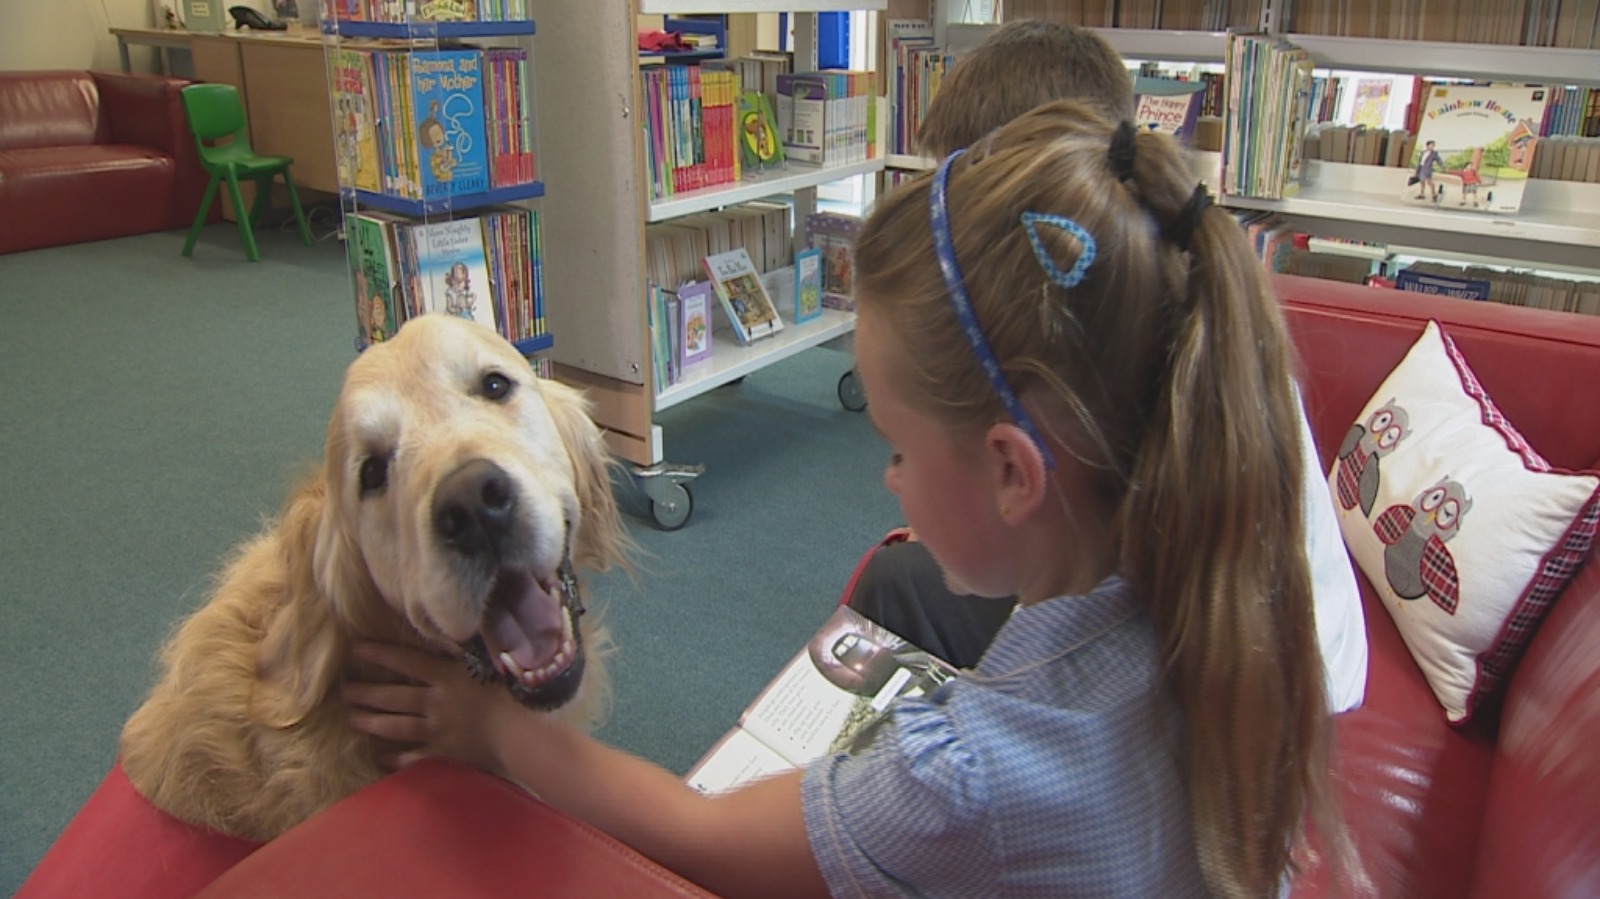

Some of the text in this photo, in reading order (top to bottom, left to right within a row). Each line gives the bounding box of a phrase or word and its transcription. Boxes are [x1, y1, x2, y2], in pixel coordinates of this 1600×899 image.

[412, 53, 477, 74] Ramona and
[416, 72, 477, 94] her Mother
[1138, 103, 1182, 123] Prince
[1142, 95, 1187, 112] The Happy
[1427, 99, 1517, 124] Rainbow House
